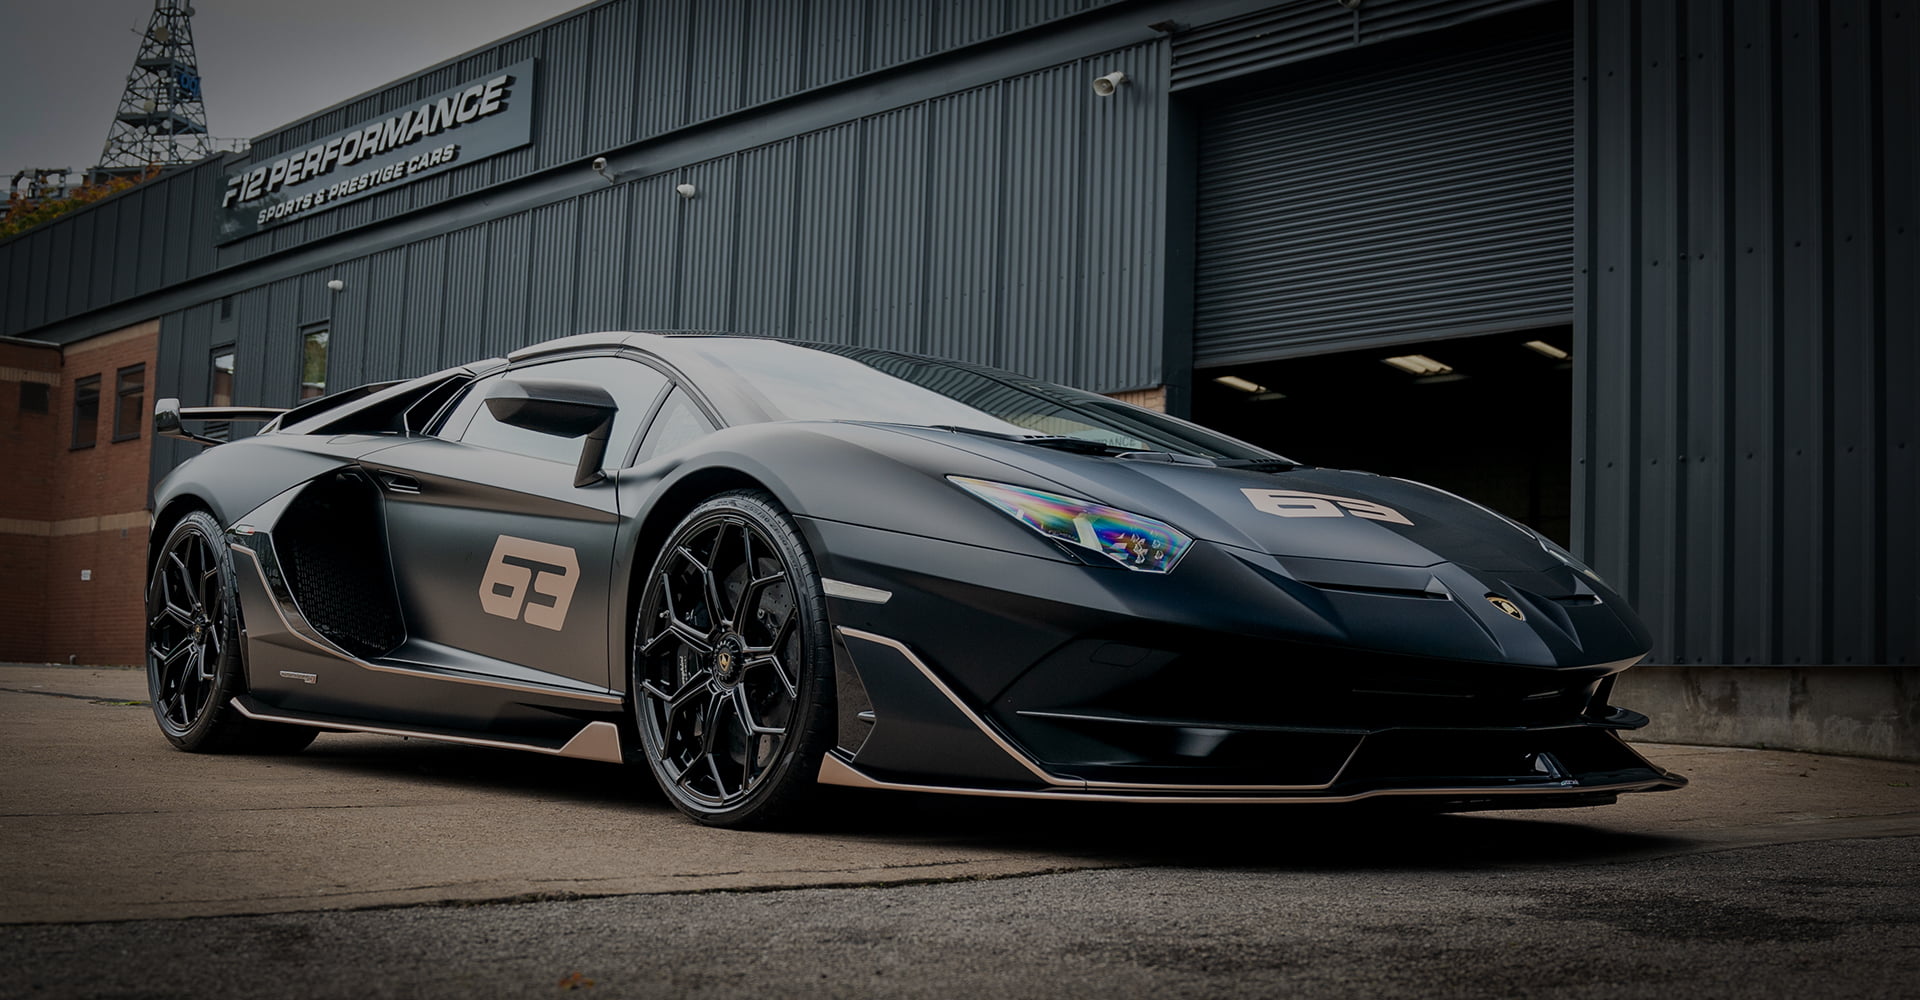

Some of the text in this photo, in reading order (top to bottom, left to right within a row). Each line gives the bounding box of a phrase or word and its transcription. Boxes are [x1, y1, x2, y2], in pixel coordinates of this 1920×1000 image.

[222, 74, 511, 208] F12 PERFORMANCE
[257, 144, 456, 225] SPORTS & PRESTIGE CARS
[1240, 488, 1415, 527] 63
[479, 534, 580, 631] 63
